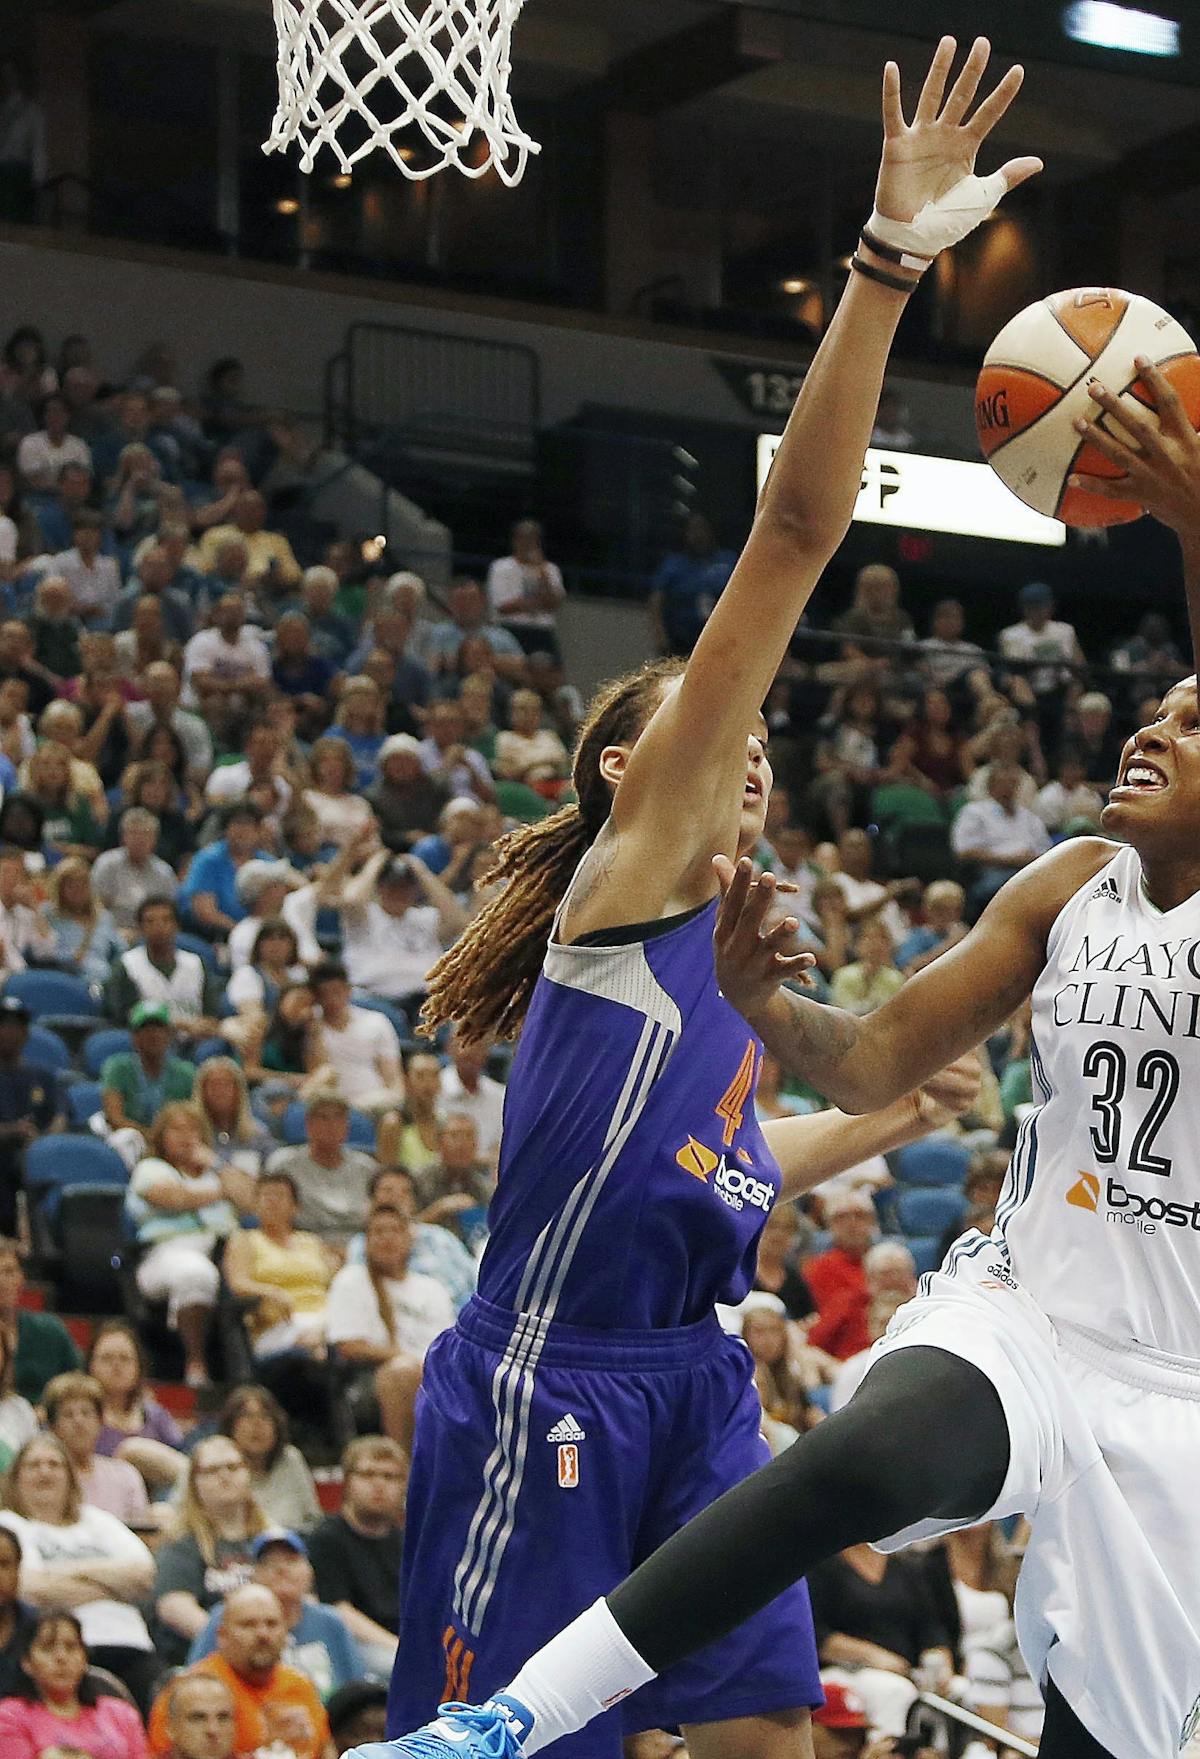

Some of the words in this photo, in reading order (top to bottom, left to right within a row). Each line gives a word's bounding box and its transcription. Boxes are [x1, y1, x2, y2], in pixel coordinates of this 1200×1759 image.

[1089, 889, 1122, 904] didas
[715, 1038, 764, 1165] 4
[1083, 1040, 1180, 1177] 32
[715, 1153, 775, 1212] boost
[1106, 1210, 1157, 1235] moile
[986, 1265, 1020, 1290] adidas
